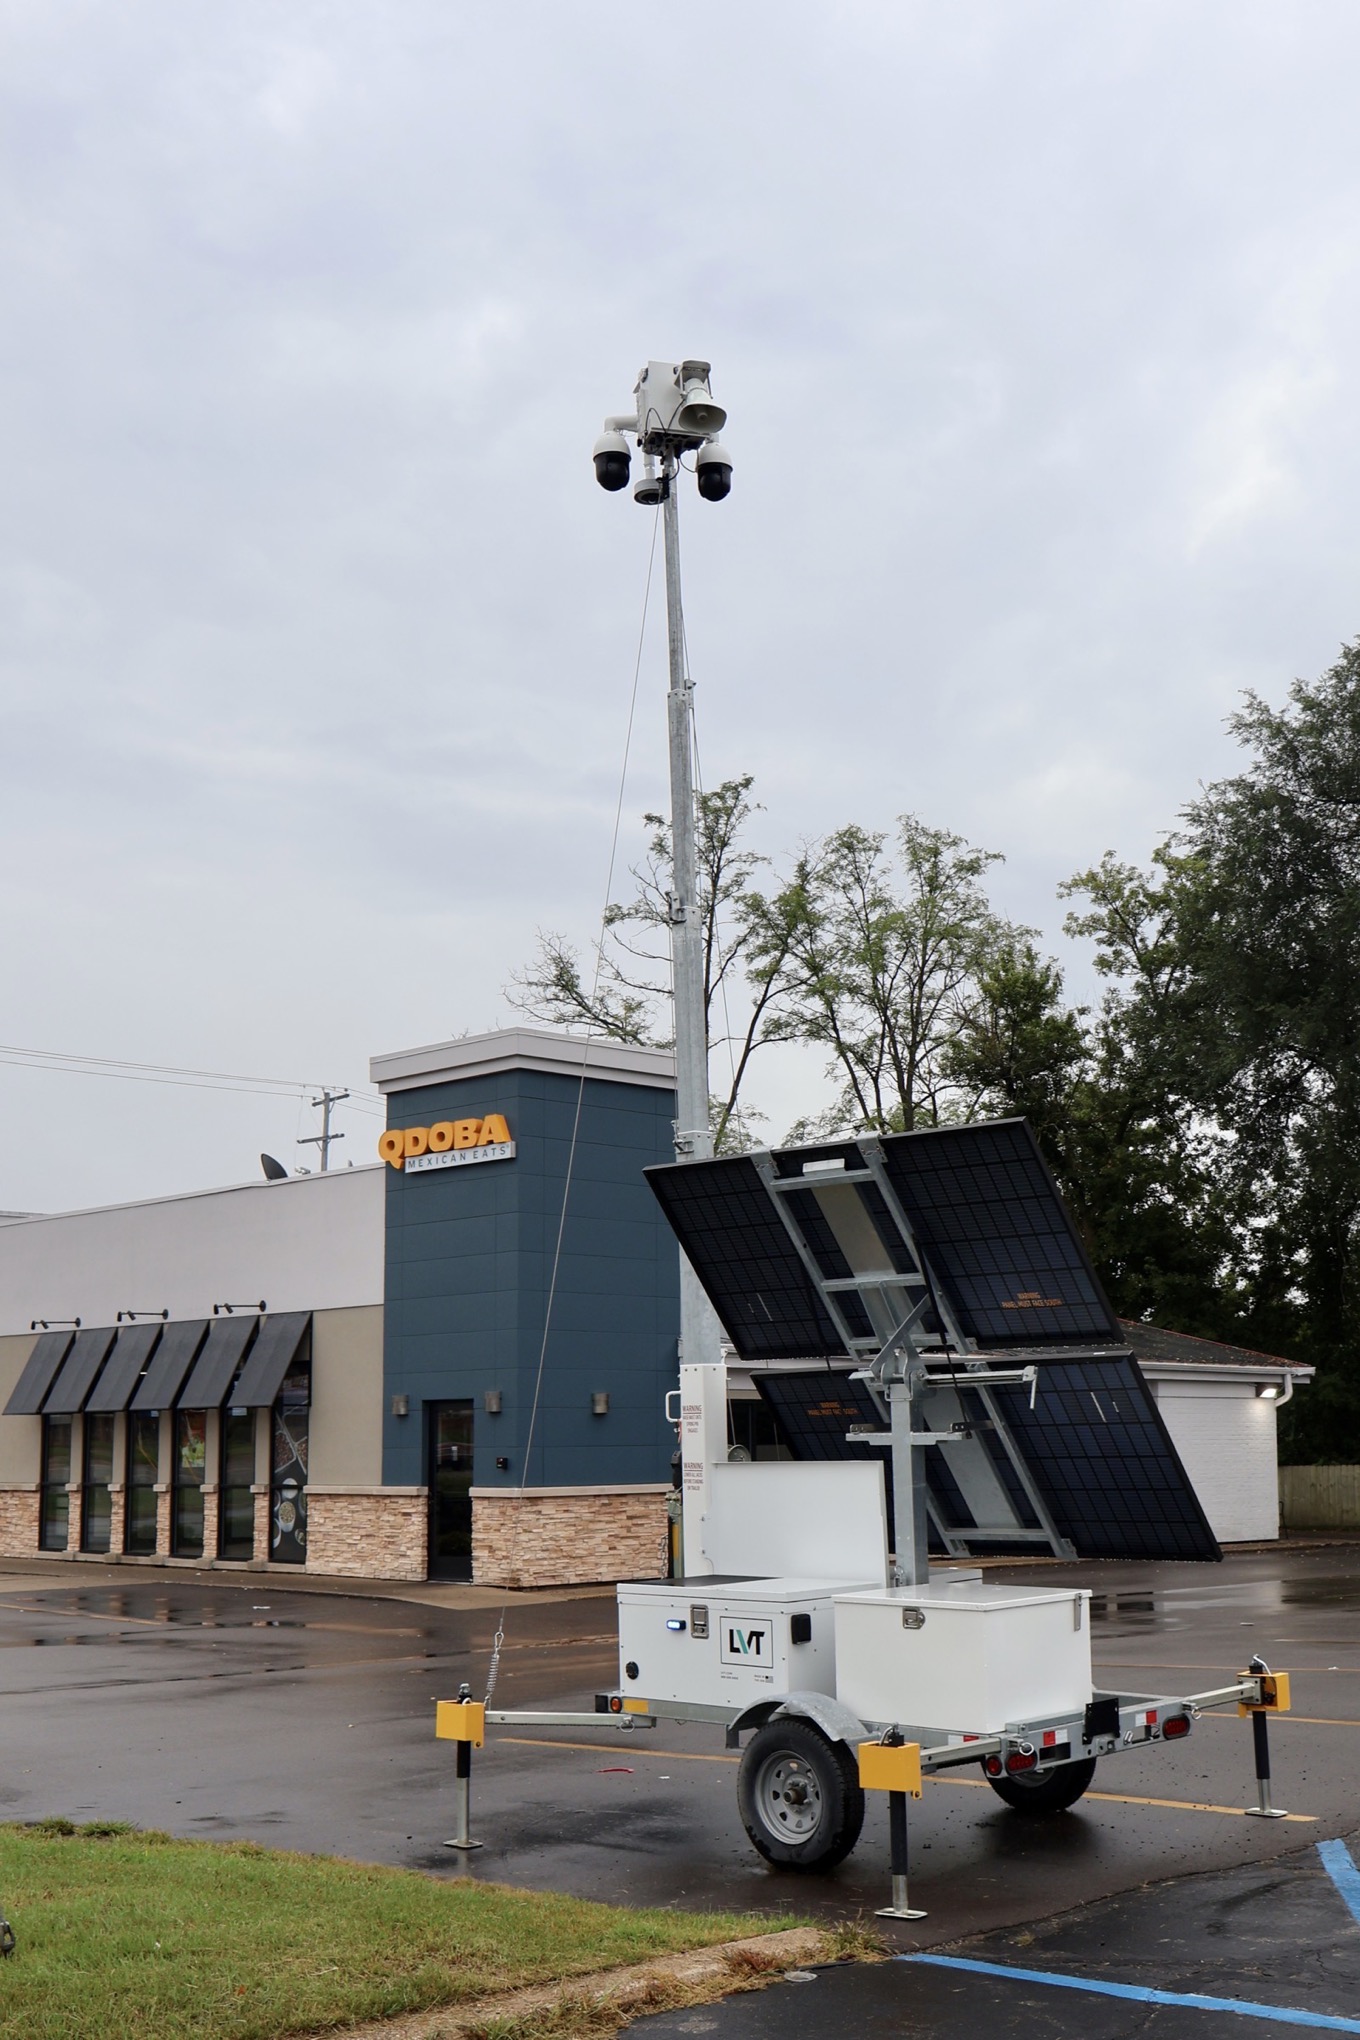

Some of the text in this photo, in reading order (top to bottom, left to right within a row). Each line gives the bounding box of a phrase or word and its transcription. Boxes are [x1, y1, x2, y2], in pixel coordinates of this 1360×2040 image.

[378, 1113, 512, 1170] QDOBA
[407, 1147, 506, 1169] MEXICAN EATS
[684, 1462, 704, 1470] WARNING
[729, 1629, 765, 1655] LVT
